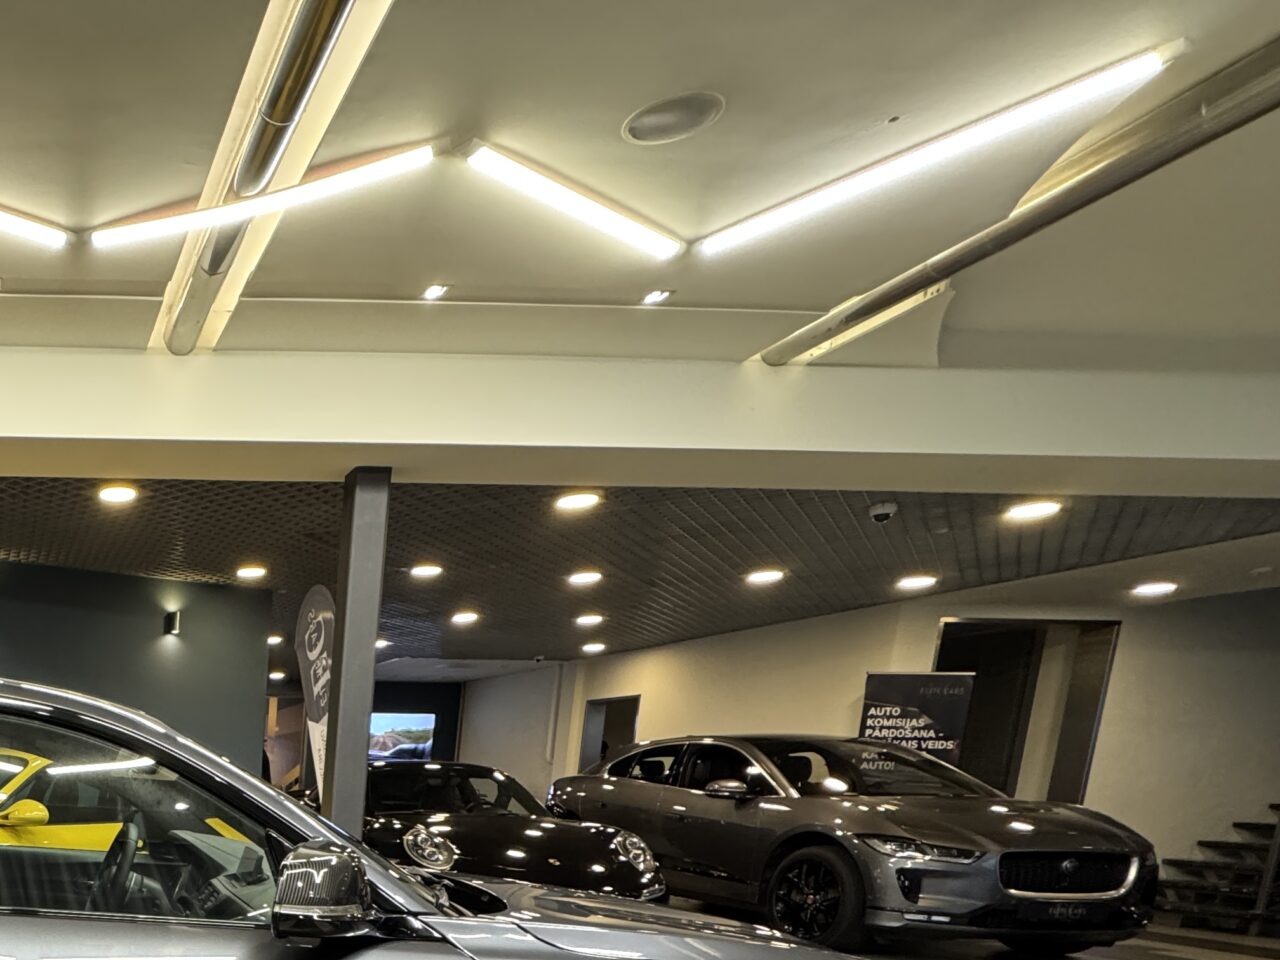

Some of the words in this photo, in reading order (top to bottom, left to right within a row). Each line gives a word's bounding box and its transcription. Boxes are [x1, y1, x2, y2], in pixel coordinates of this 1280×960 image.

[867, 706, 901, 716] AUTO
[866, 717, 925, 728] KOMISIJAS
[864, 727, 936, 738] PĀRDOŠANA
[859, 761, 895, 770] AUTO!
